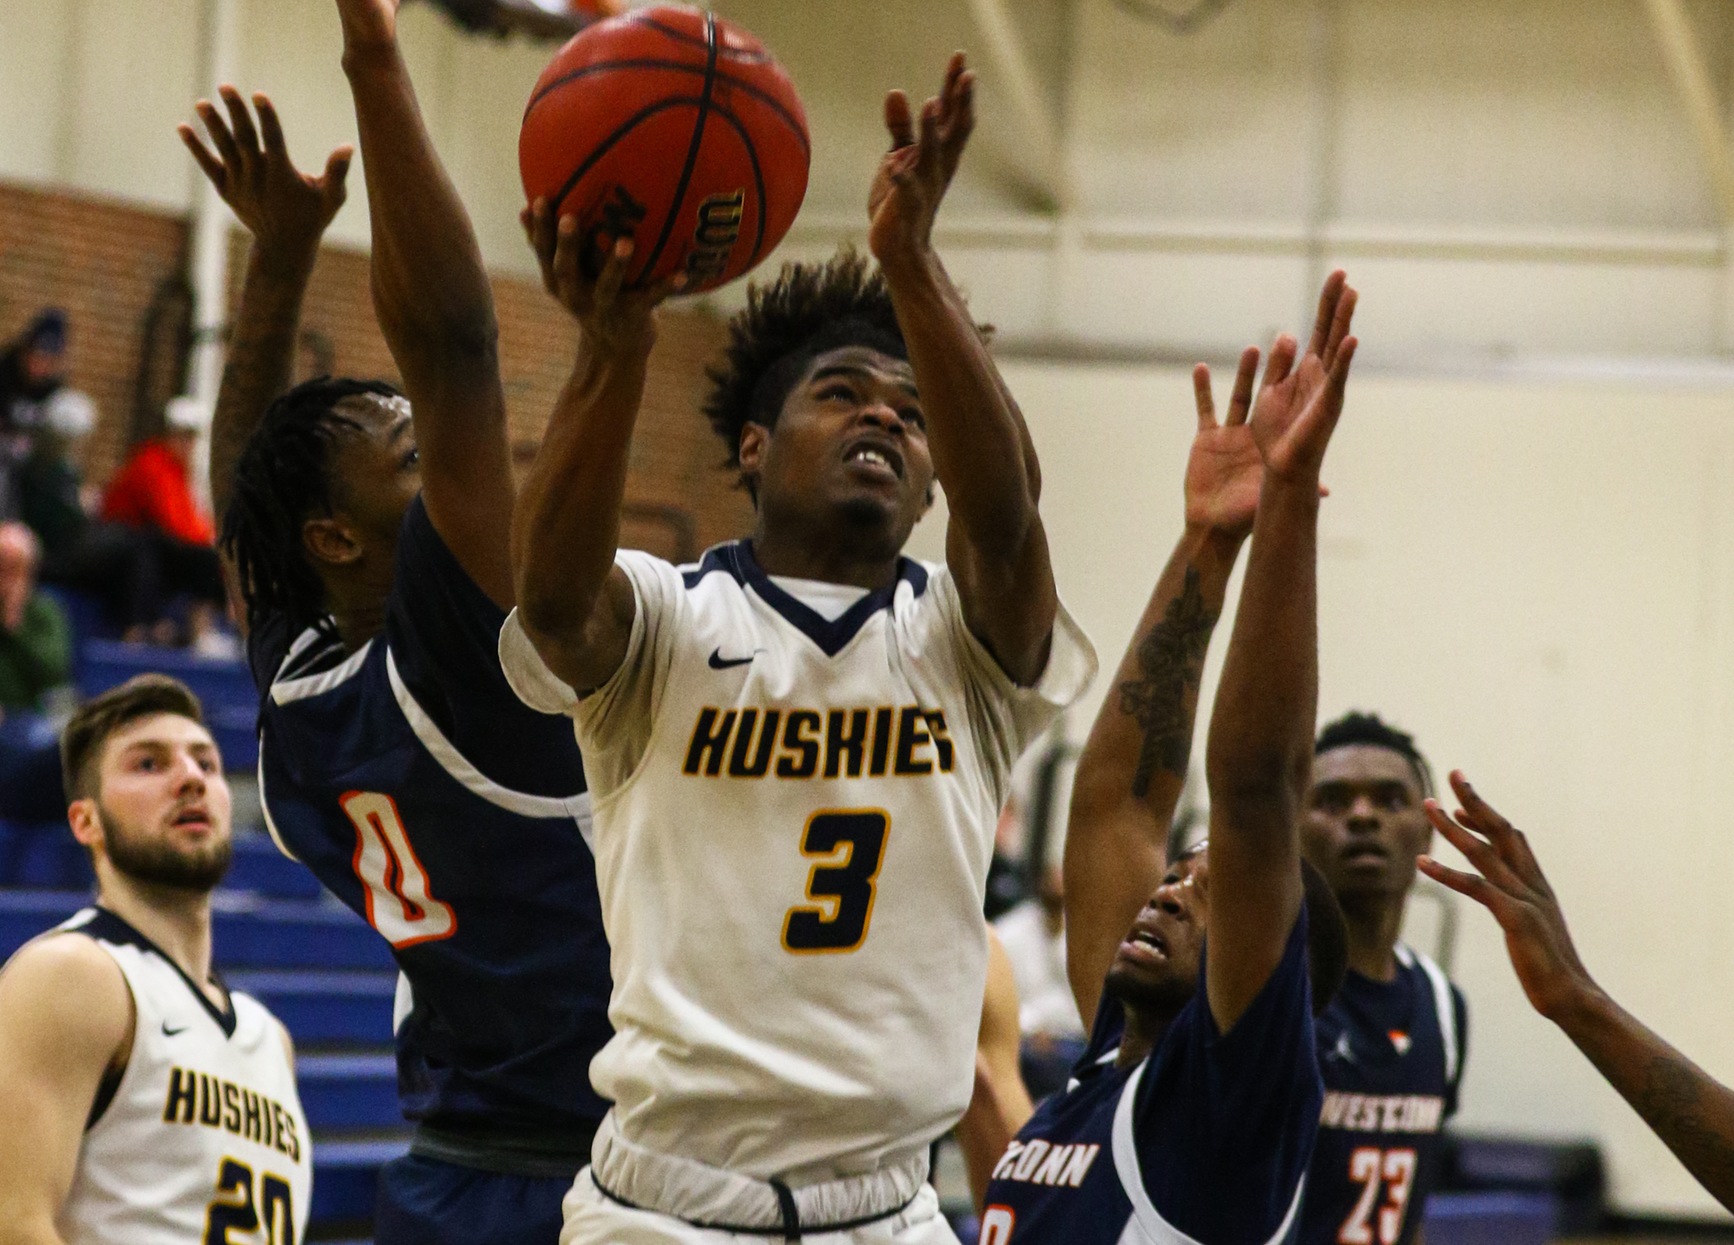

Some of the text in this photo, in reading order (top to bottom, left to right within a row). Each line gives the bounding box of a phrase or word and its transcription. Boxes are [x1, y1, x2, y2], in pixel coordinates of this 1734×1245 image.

[682, 705, 955, 780] HUSHIES
[338, 790, 458, 950] 0
[780, 807, 891, 956] 3
[163, 1067, 300, 1165] HUSHIES
[1337, 1147, 1417, 1245] 23
